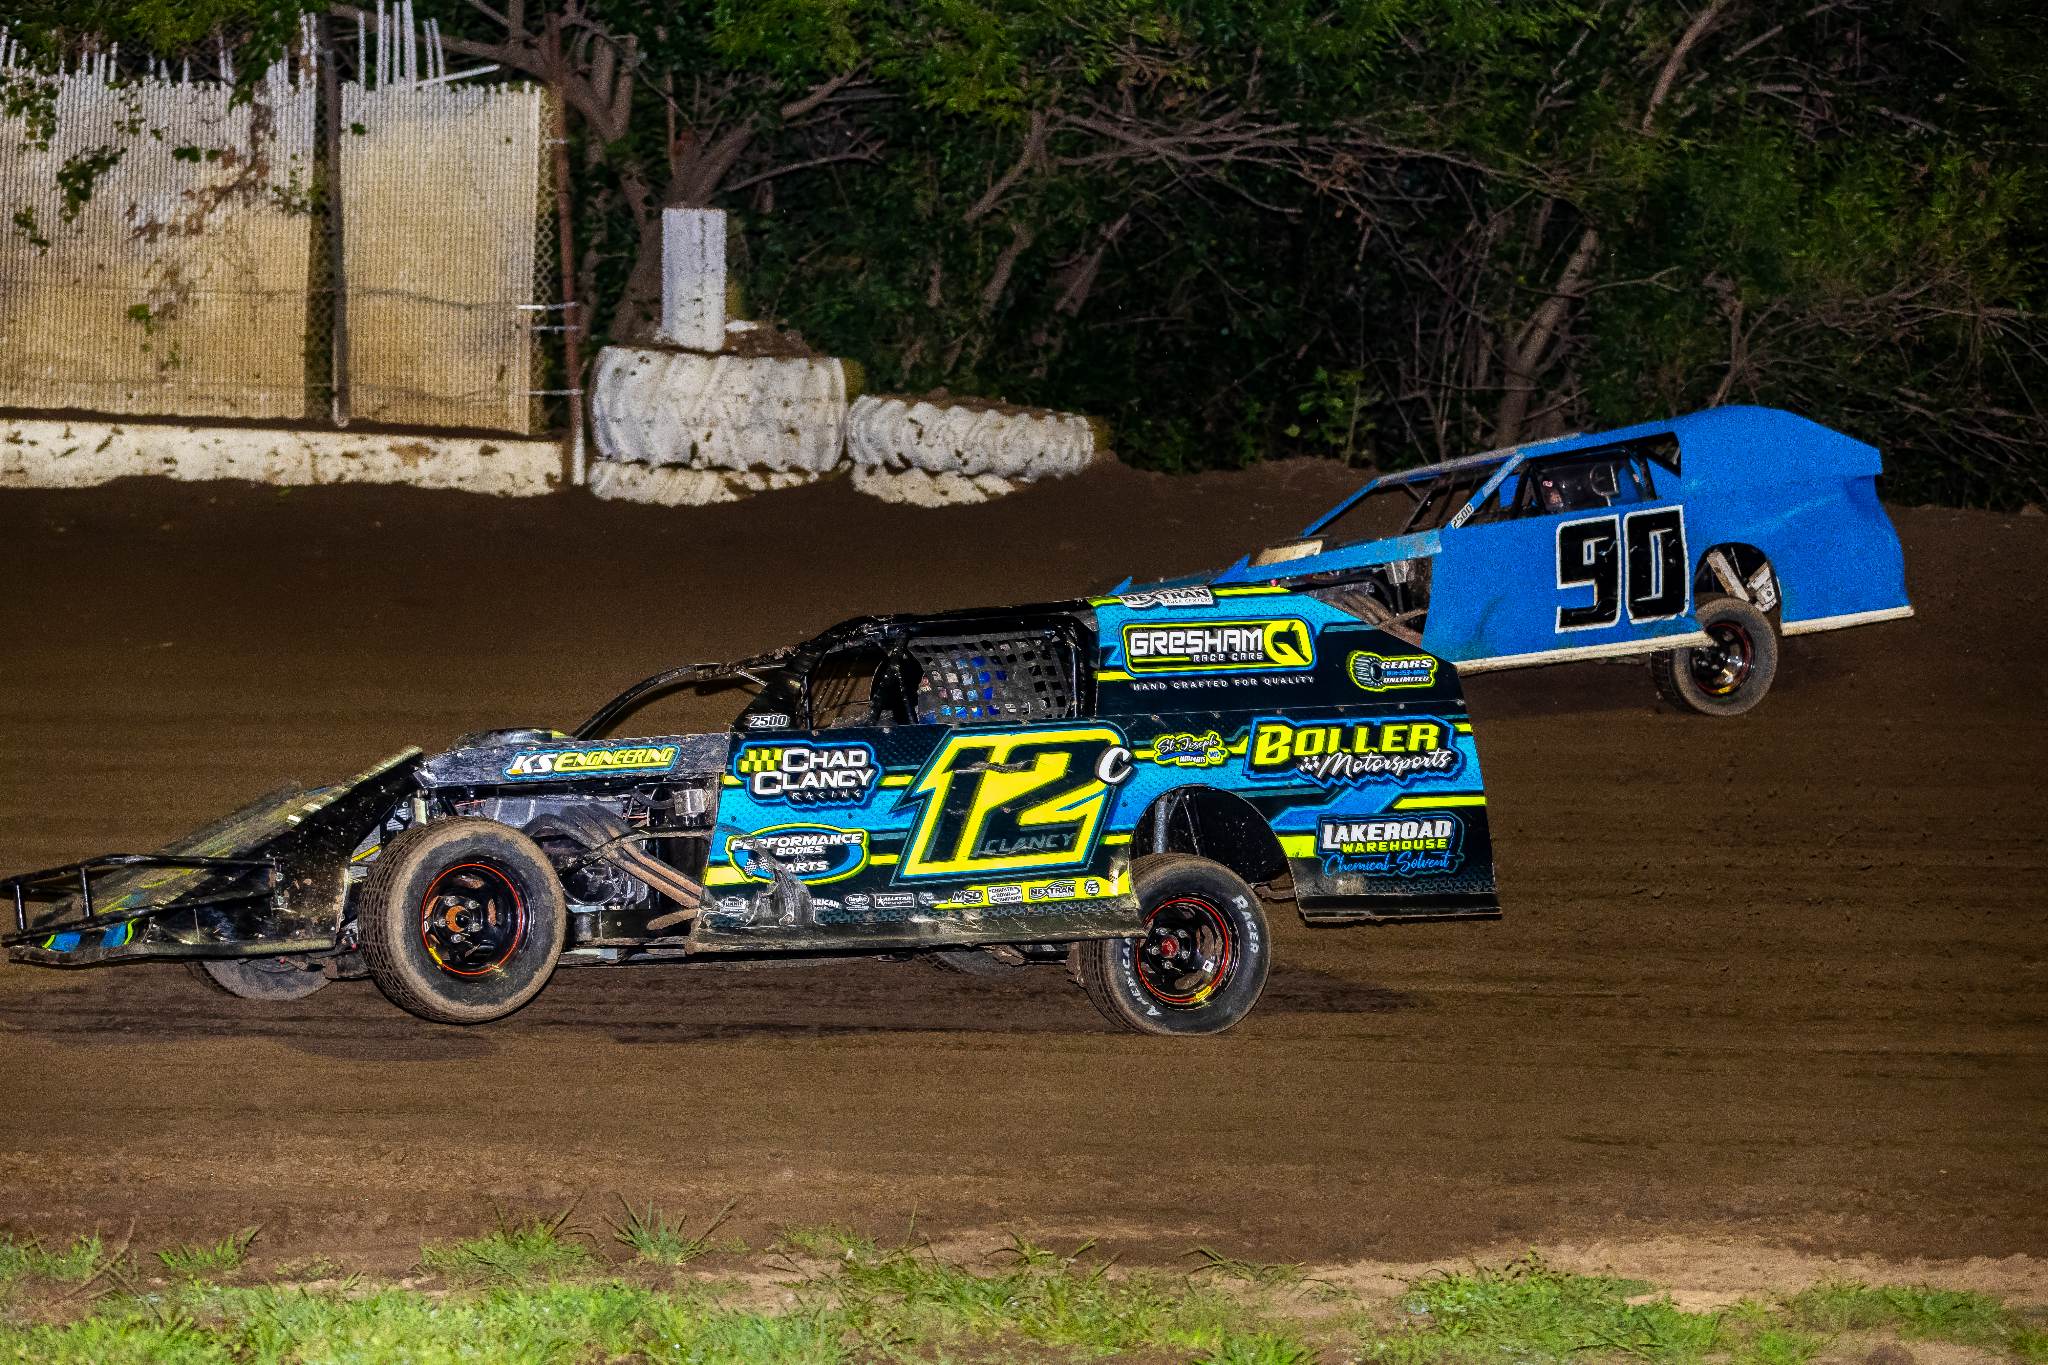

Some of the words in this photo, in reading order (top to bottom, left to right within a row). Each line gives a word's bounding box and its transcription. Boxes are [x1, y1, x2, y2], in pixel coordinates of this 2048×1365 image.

[1452, 504, 1473, 528] 2500
[1555, 505, 1690, 633] 90
[1122, 587, 1210, 602] NEXTRAN
[1130, 629, 1263, 656] GRESHAM
[1193, 653, 1225, 662] RACE
[1232, 652, 1263, 661] CARS
[1380, 660, 1432, 669] GEARS
[1133, 682, 1166, 691] HAND
[1174, 680, 1227, 689] CRAFTED
[1235, 678, 1257, 686] FOR
[1265, 676, 1314, 685] QUALITY
[1383, 676, 1429, 684] UNLIMITED
[751, 714, 788, 727] 2500
[1178, 734, 1218, 752] Joseph
[1254, 724, 1439, 765] BOLLER
[509, 753, 558, 774] KS
[554, 747, 676, 771] ENGINEERING
[783, 749, 867, 772] CHAD
[1317, 748, 1453, 778] Motorsports
[754, 769, 874, 795] CLANCY
[792, 789, 862, 801] RACING
[903, 728, 1121, 876] 12
[731, 833, 863, 850] PERFORMANCE
[985, 833, 1077, 853] CLANCY
[1322, 821, 1452, 849] LAKEROAD
[776, 846, 824, 856] BODIES
[1341, 838, 1447, 854] WAREHOUSE
[780, 861, 828, 873] ARTS
[952, 891, 983, 903] MSD
[1030, 886, 1076, 896] NEXTRAN
